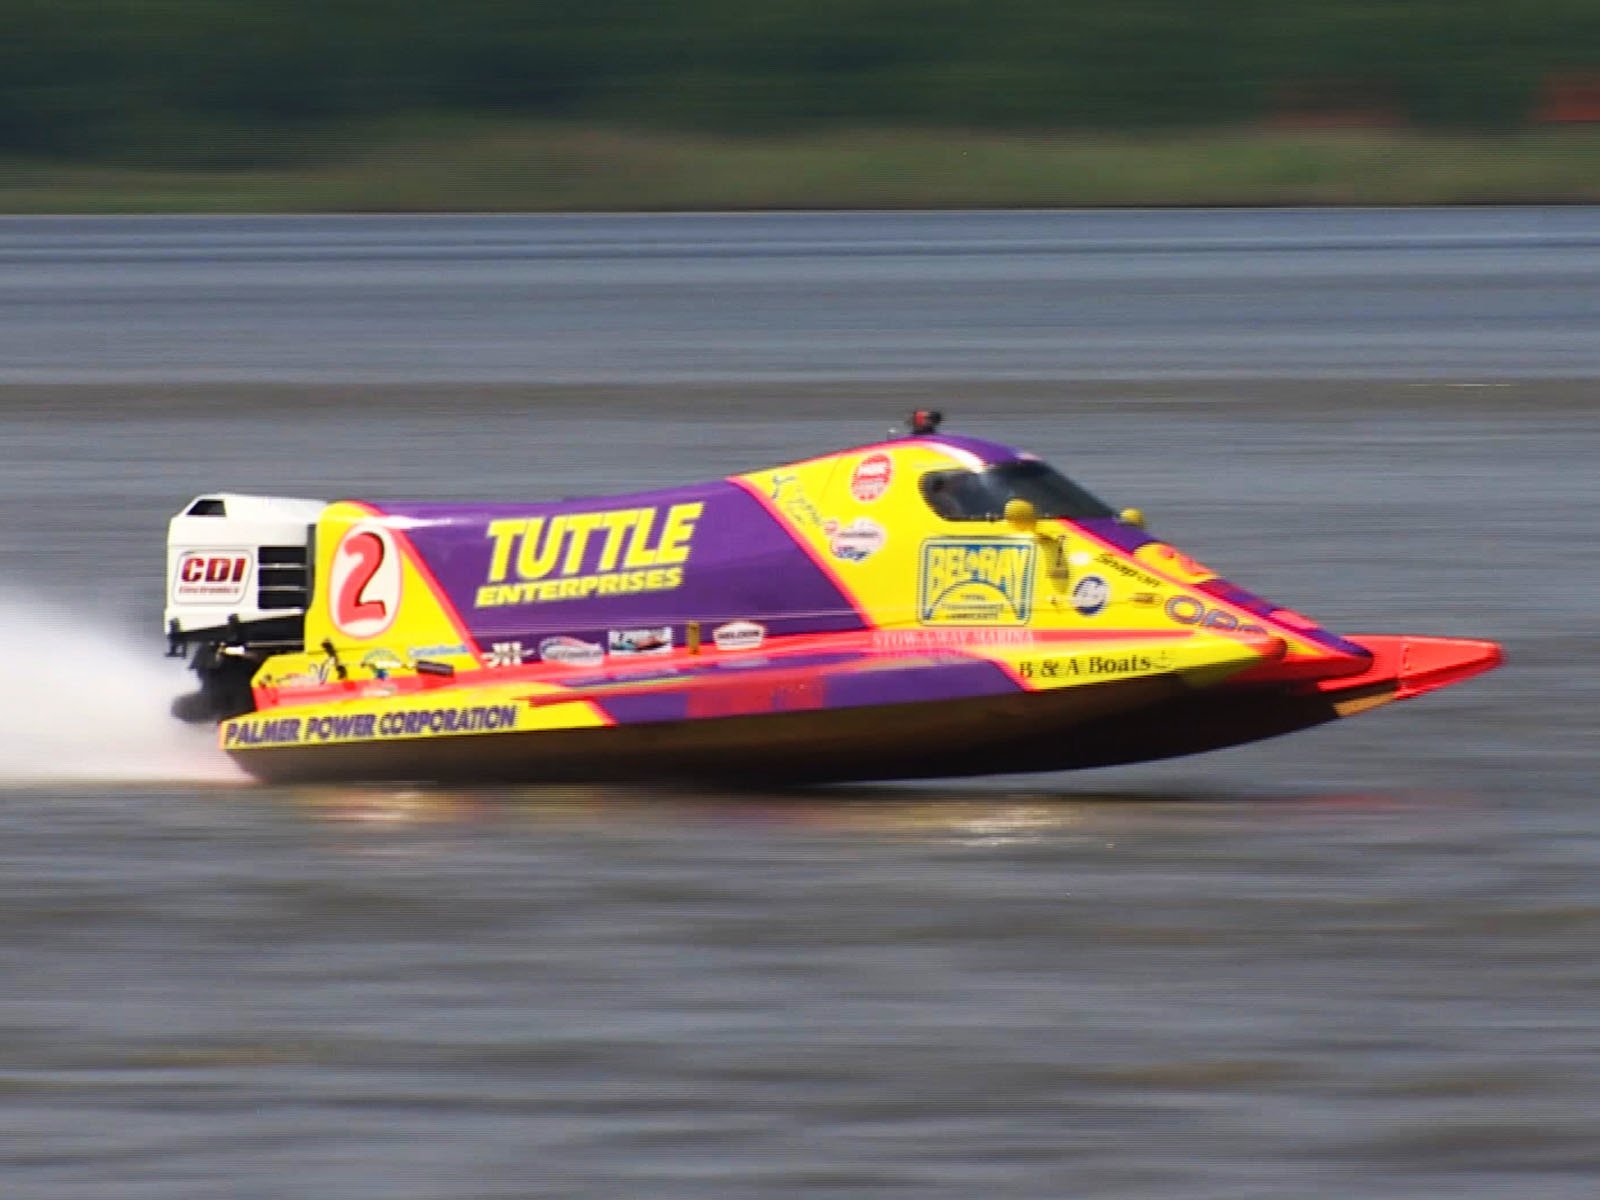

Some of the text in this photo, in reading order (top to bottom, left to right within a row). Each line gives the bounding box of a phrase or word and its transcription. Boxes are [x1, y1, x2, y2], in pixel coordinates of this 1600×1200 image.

[488, 502, 705, 583] TUTTLE
[181, 558, 246, 582] CDI
[337, 531, 386, 627] 2
[475, 566, 685, 608] ENTERPRISES
[1020, 654, 1150, 678] B & A Boats
[225, 705, 518, 745] PALMER POWER CORPORATION
